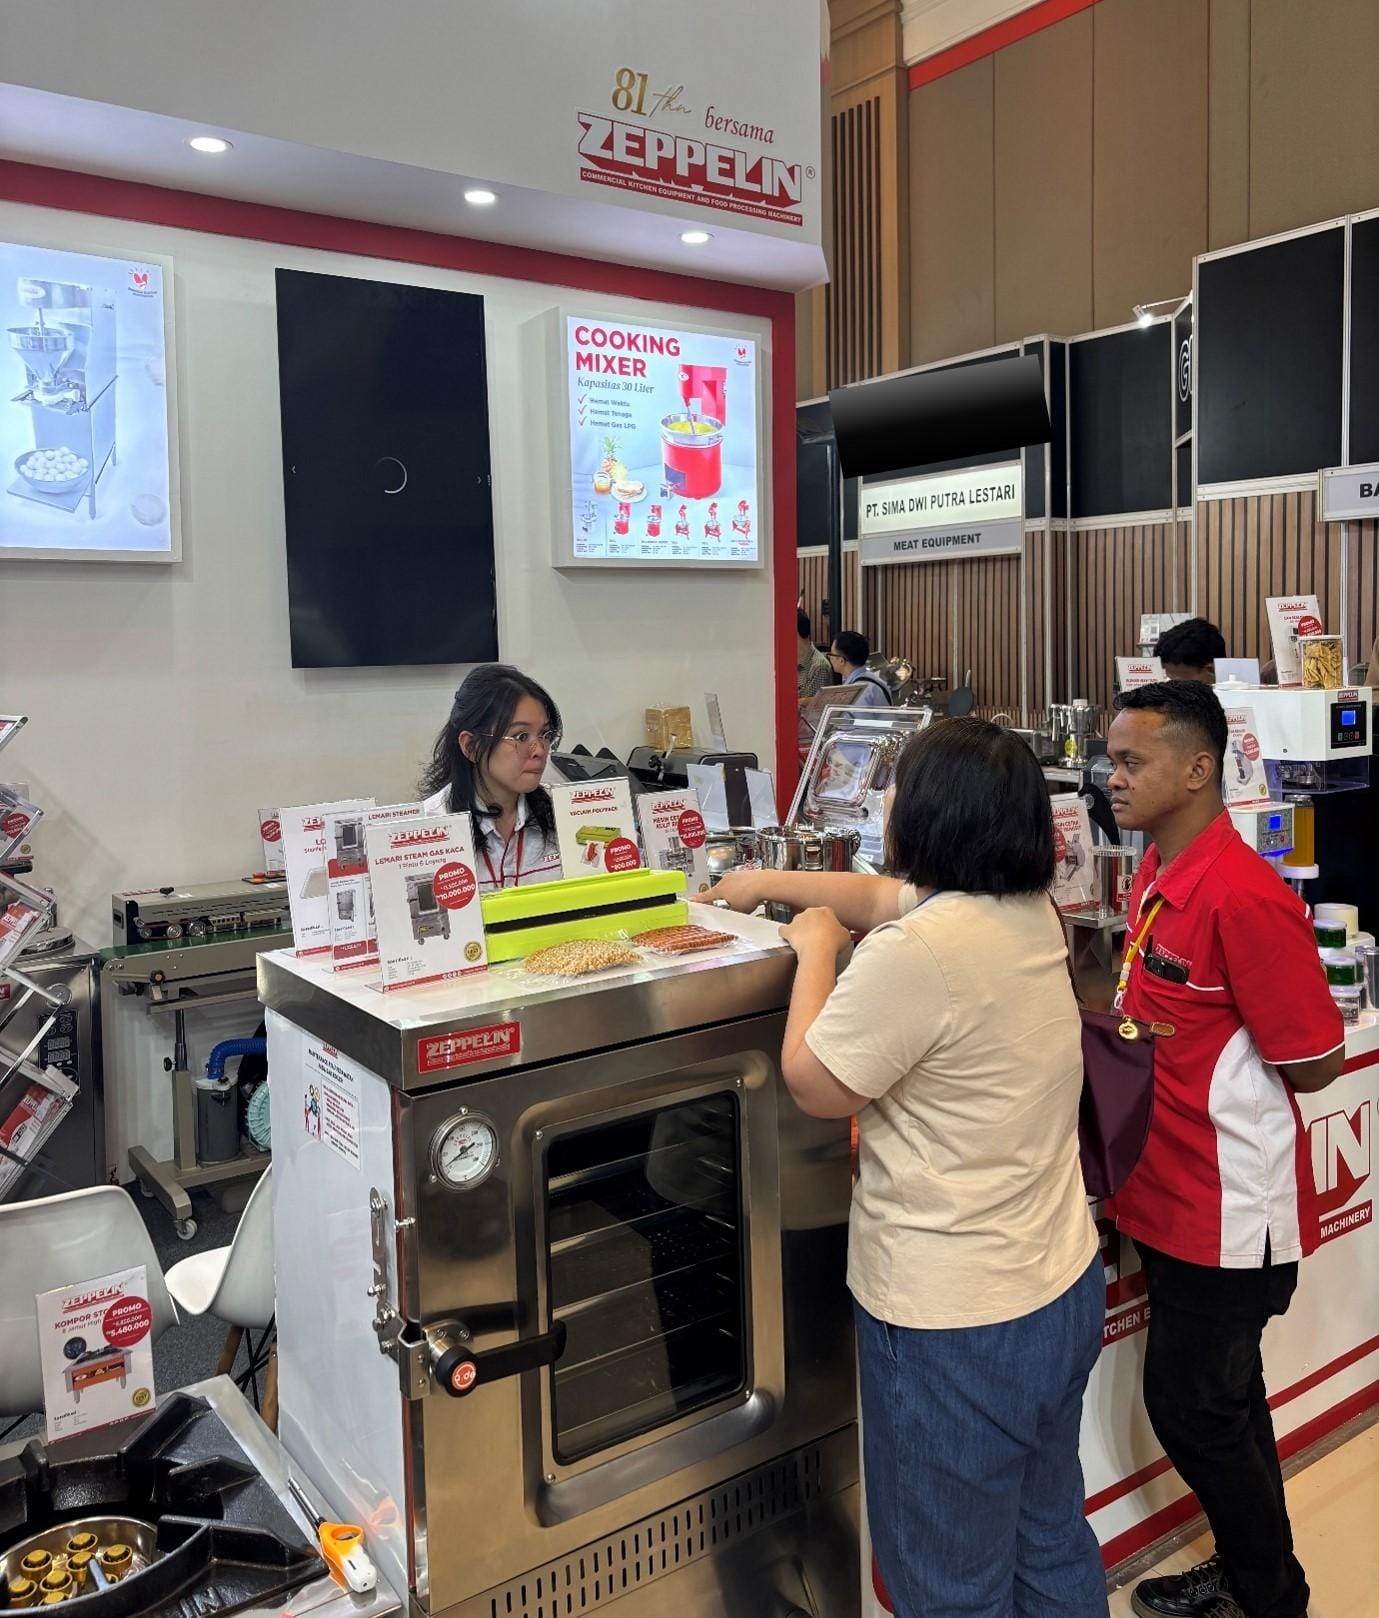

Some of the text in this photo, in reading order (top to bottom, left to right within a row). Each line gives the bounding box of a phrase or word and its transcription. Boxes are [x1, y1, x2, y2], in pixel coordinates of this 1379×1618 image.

[612, 67, 648, 117] 81
[705, 106, 775, 144] bersama
[578, 112, 802, 208] ZEPPELIN
[582, 171, 801, 224] COMMERCIAL KITCHEN EQUIPMENT AND FOOD PROCESSING MACHINERY
[575, 326, 680, 357] COOKING
[576, 351, 647, 378] MIXER
[578, 377, 655, 394] Kapasitas 30 Liter
[866, 484, 1015, 518] PT. SIMA DWI PUTRA LESTARI
[894, 533, 982, 551] MEAT EQUIPMENT
[390, 826, 450, 844] ZEPPELIN
[375, 846, 465, 866] LEMARI STEAM GAS KACA
[438, 867, 465, 881] PROMO
[426, 1028, 511, 1057] ZEPPELIN
[1320, 1206, 1371, 1239] MACHINERY
[54, 1313, 91, 1329] KOMPOR
[112, 1303, 142, 1317] PROMO
[1104, 1312, 1141, 1338] TCHEN
